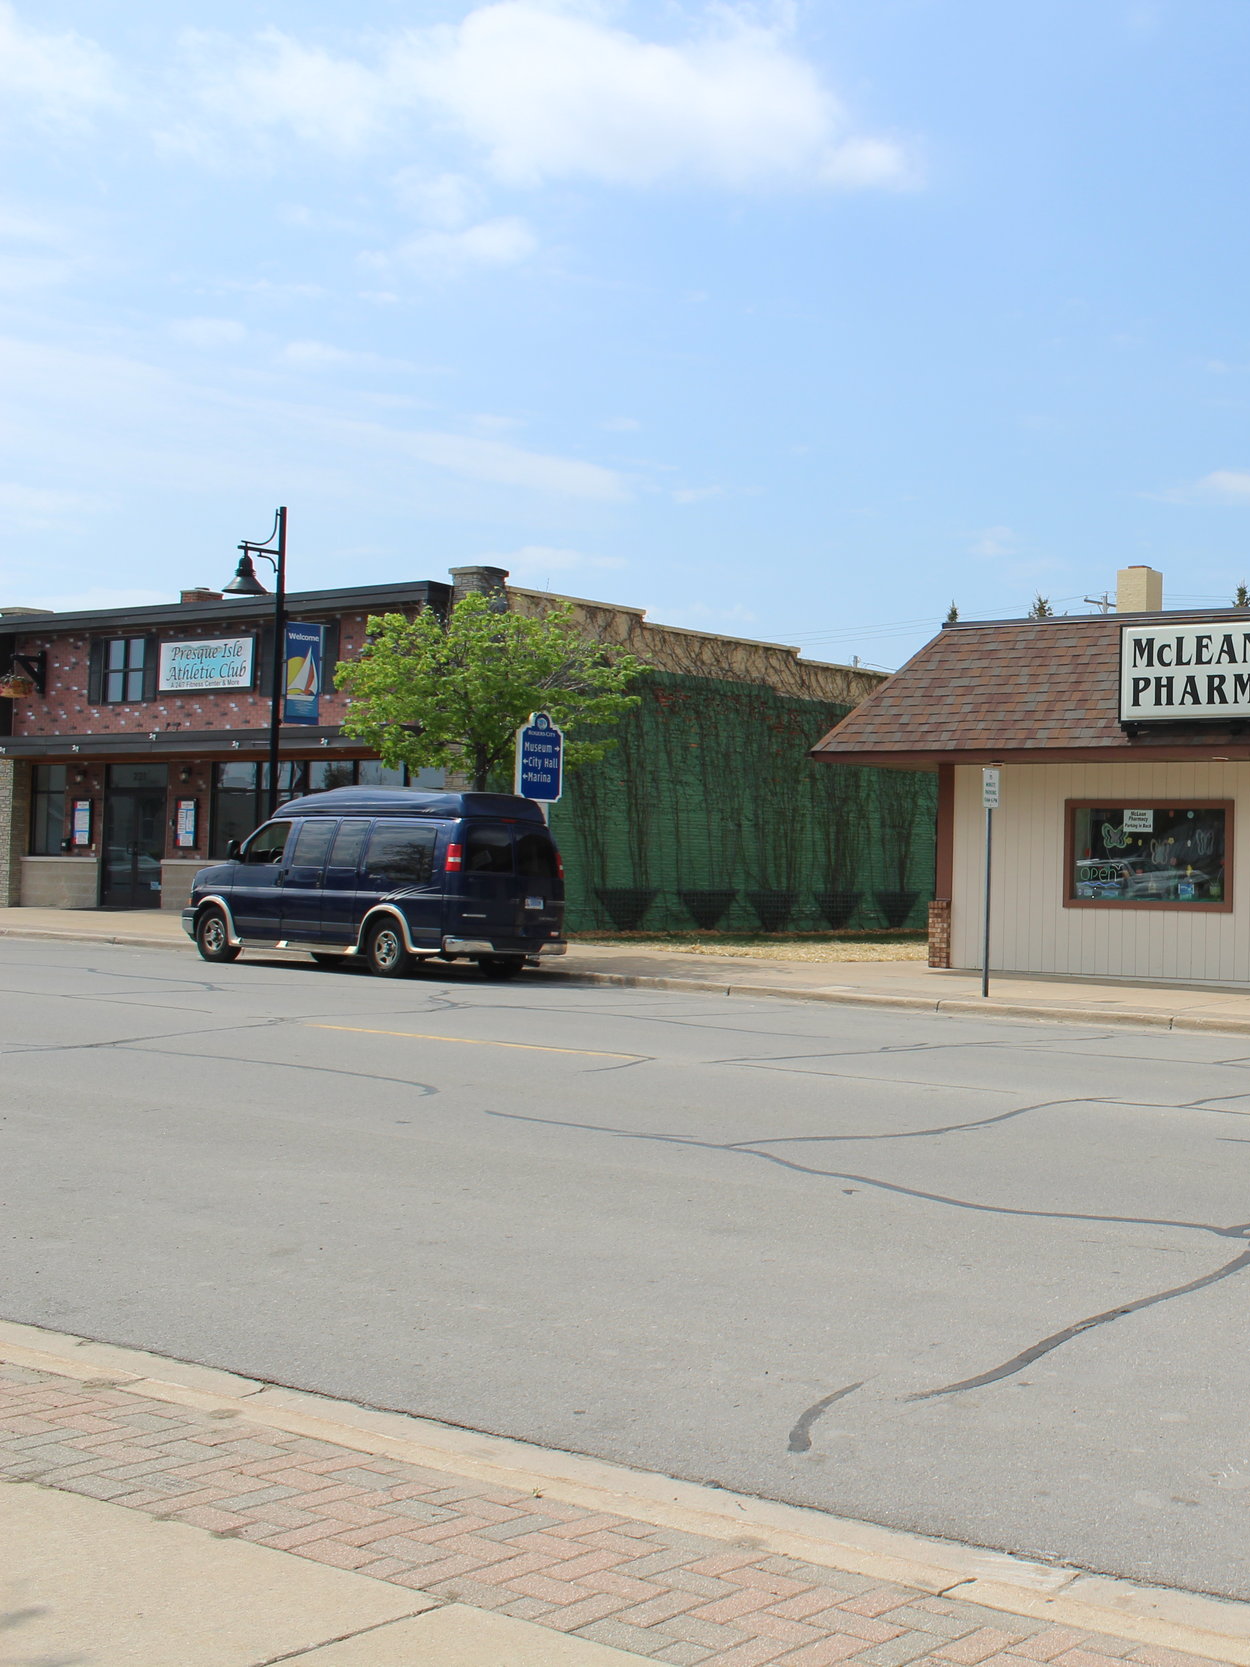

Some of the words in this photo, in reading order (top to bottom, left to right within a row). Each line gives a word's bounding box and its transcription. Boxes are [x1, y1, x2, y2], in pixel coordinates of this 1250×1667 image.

[288, 632, 320, 642] Welcome
[171, 645, 219, 664] Presque
[220, 640, 243, 658] Isle
[166, 664, 216, 682] Athletic
[219, 659, 247, 679] Club
[186, 680, 204, 688] Fitness
[204, 679, 221, 687] Center
[227, 678, 240, 686] More
[524, 741, 553, 753] Museum
[528, 756, 542, 769] City
[544, 758, 558, 769] Hall
[528, 771, 552, 783] Marina
